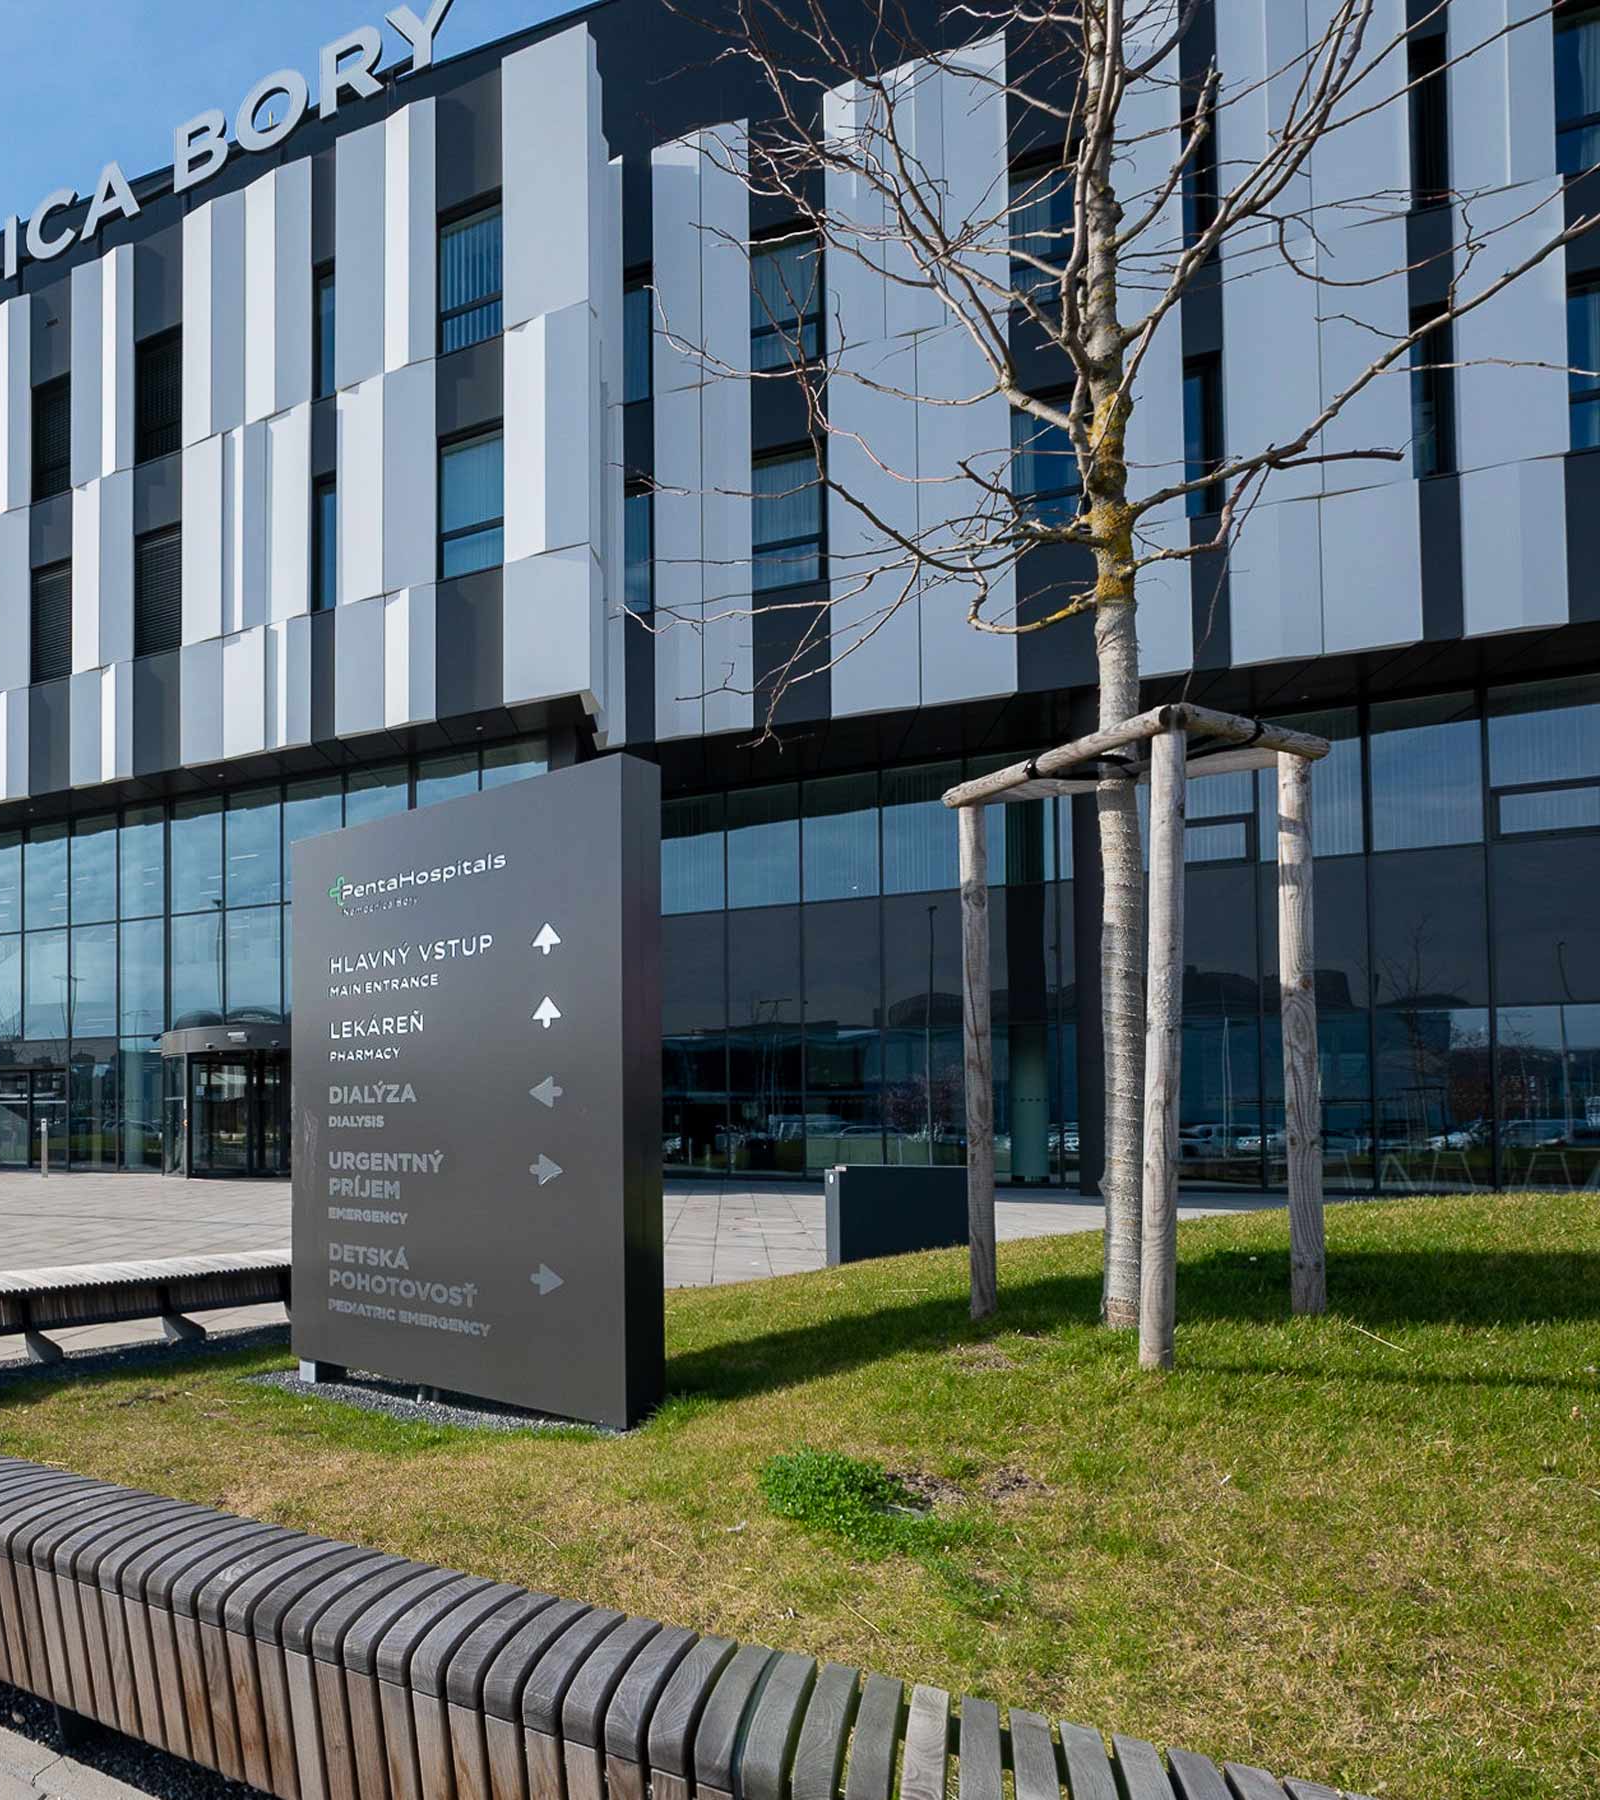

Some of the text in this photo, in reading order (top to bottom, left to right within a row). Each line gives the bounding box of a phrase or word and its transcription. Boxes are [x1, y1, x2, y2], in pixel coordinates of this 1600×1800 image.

[174, 0, 453, 194] BORY
[342, 853, 507, 900] PentaHospitals
[330, 934, 493, 974] HLAVNÝ VSTUP
[330, 974, 438, 997] MAIN ENTRANCE
[330, 1010, 424, 1039] LEKÁREŇ
[330, 1047, 401, 1062] PHARMACY
[329, 1080, 417, 1104] DIALÝZA
[328, 1115, 385, 1128] DIALYSIS
[328, 1149, 444, 1173] URGENTNÝ
[329, 1175, 401, 1200] PRÍJEM
[328, 1206, 408, 1225] EMERGENCY
[328, 1242, 409, 1270] DETSKÁ
[328, 1268, 478, 1308] POHOTOVOSŤ
[328, 1298, 491, 1337] PEDIATRIC EMERGENCY
